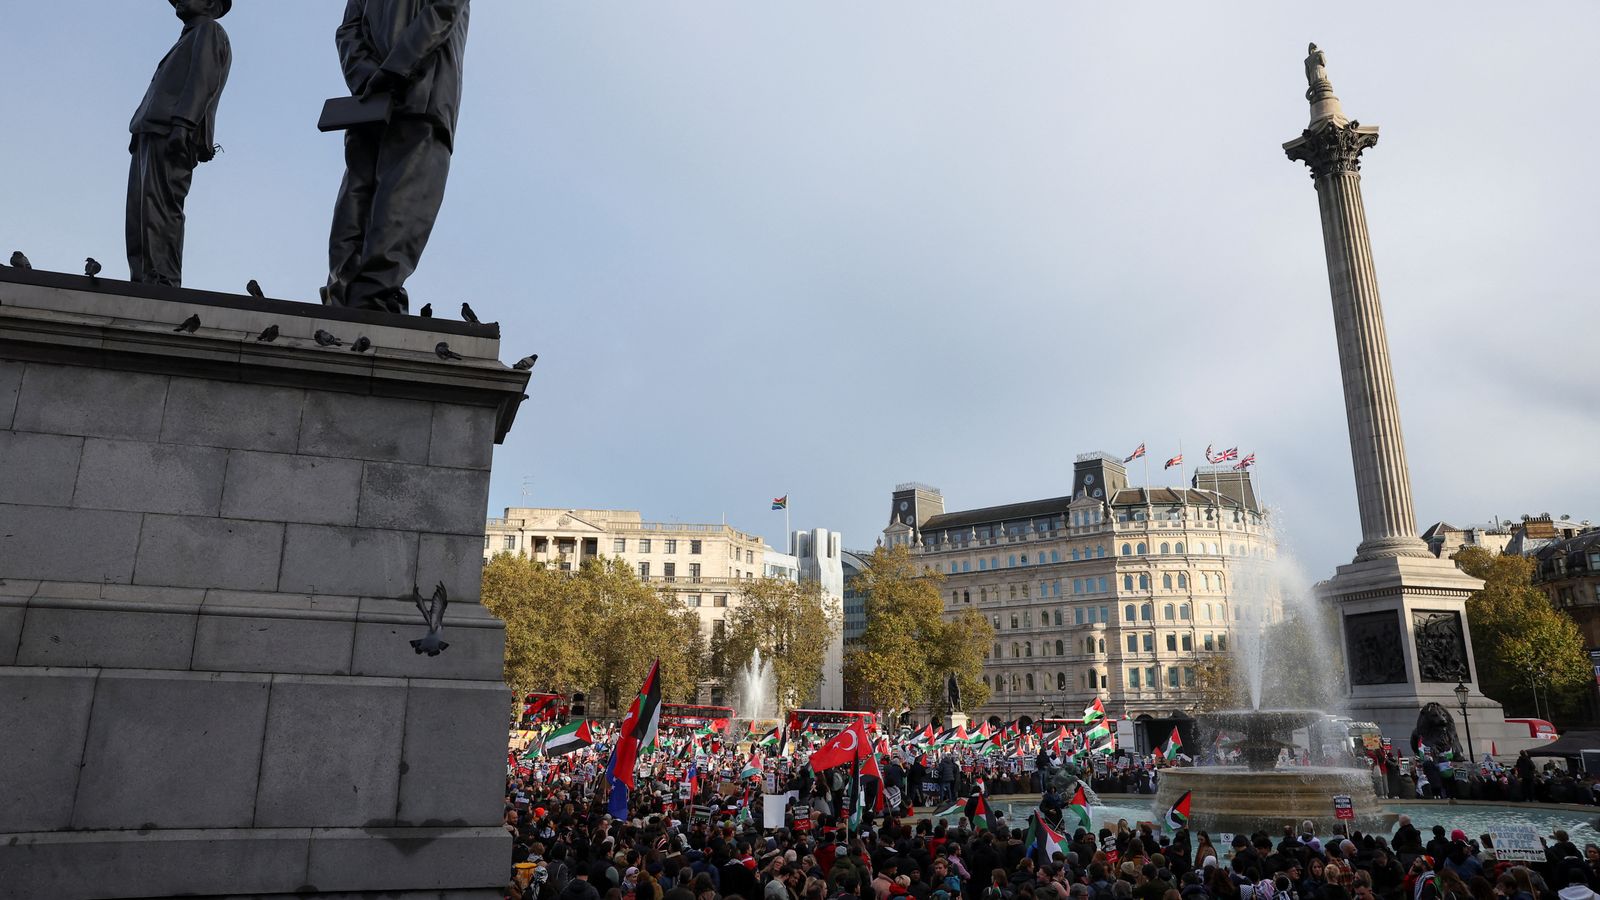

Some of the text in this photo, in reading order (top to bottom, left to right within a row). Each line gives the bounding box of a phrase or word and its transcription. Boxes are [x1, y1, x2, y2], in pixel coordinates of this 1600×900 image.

[1496, 840, 1533, 849] A FREE
[1497, 849, 1545, 860] PALESTINE
